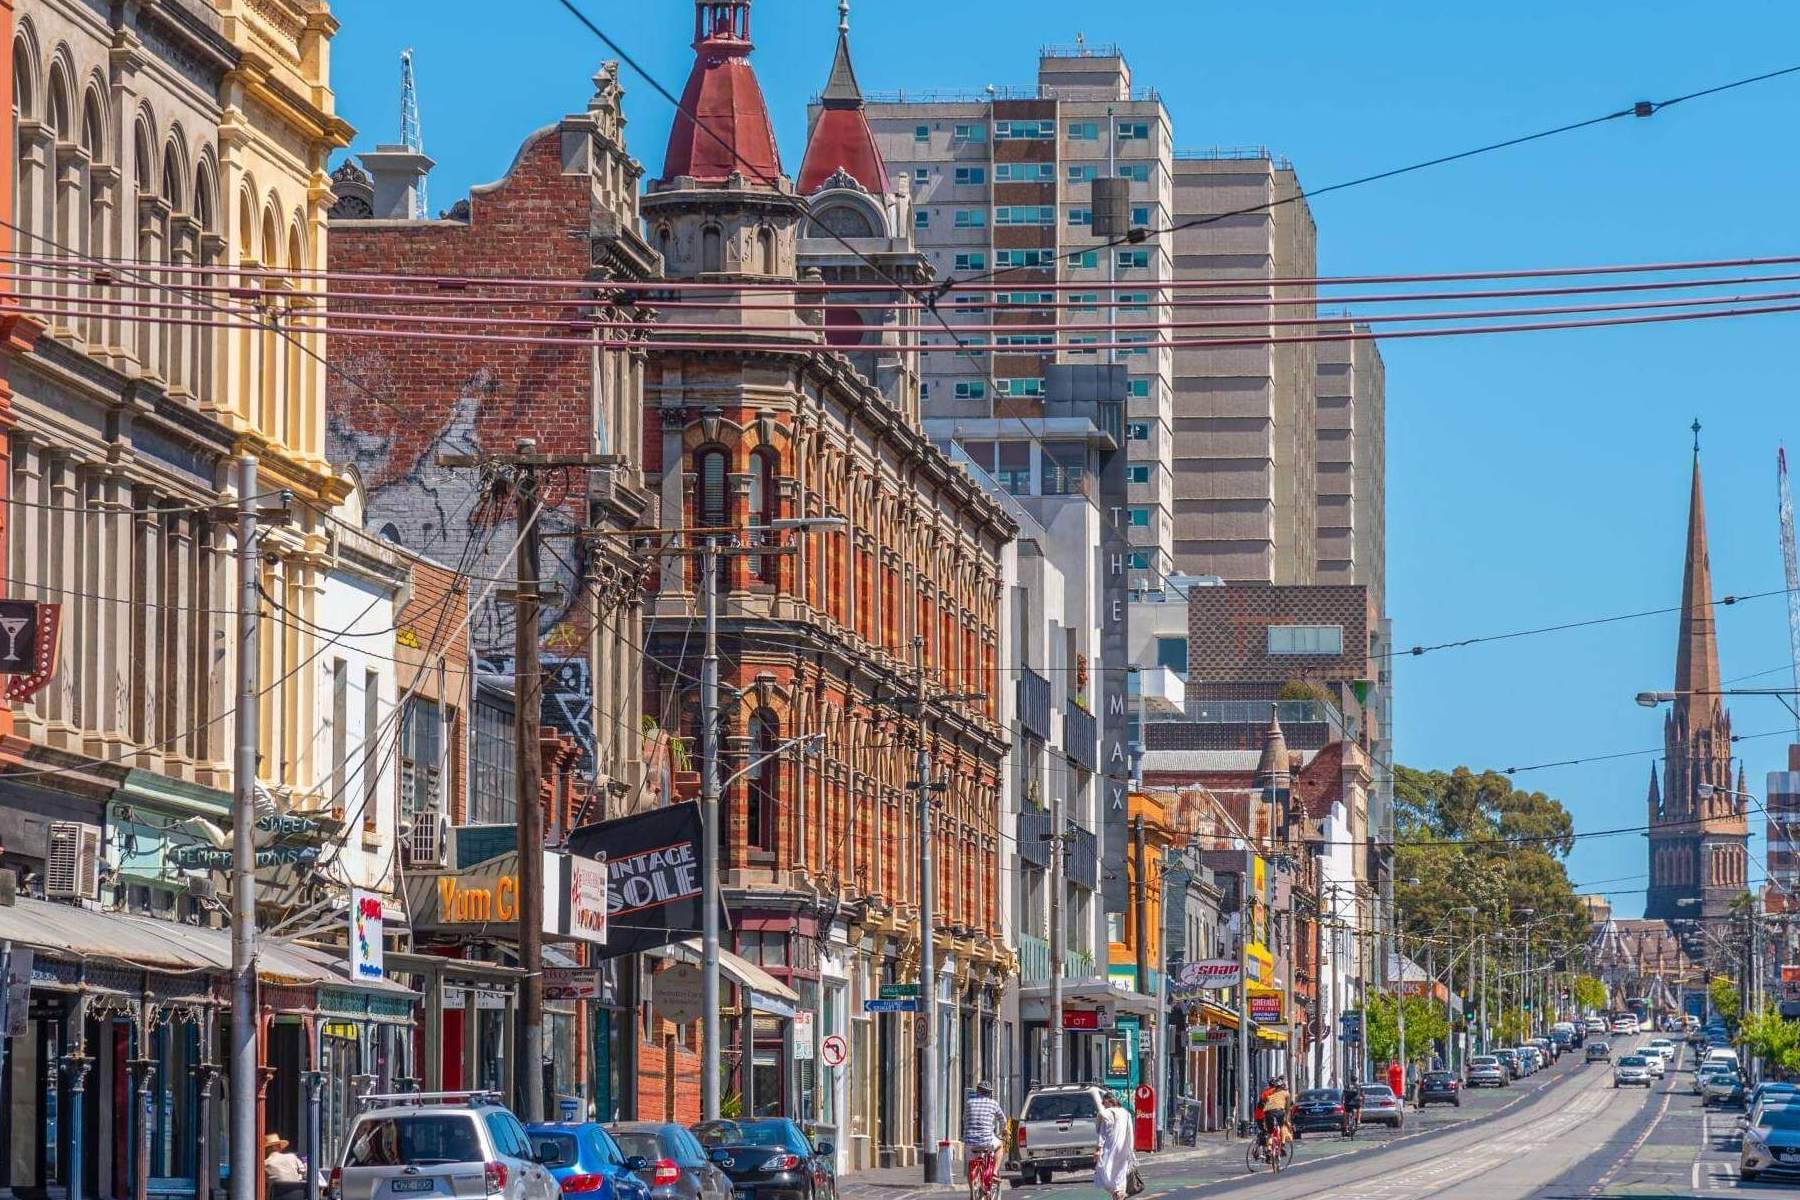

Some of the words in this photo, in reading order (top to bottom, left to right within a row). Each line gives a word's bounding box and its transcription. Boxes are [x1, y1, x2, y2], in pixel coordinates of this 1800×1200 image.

[1110, 507, 1122, 621] THE
[1110, 694, 1124, 810] MAX
[439, 877, 491, 922] Yum
[1198, 965, 1239, 975] snap
